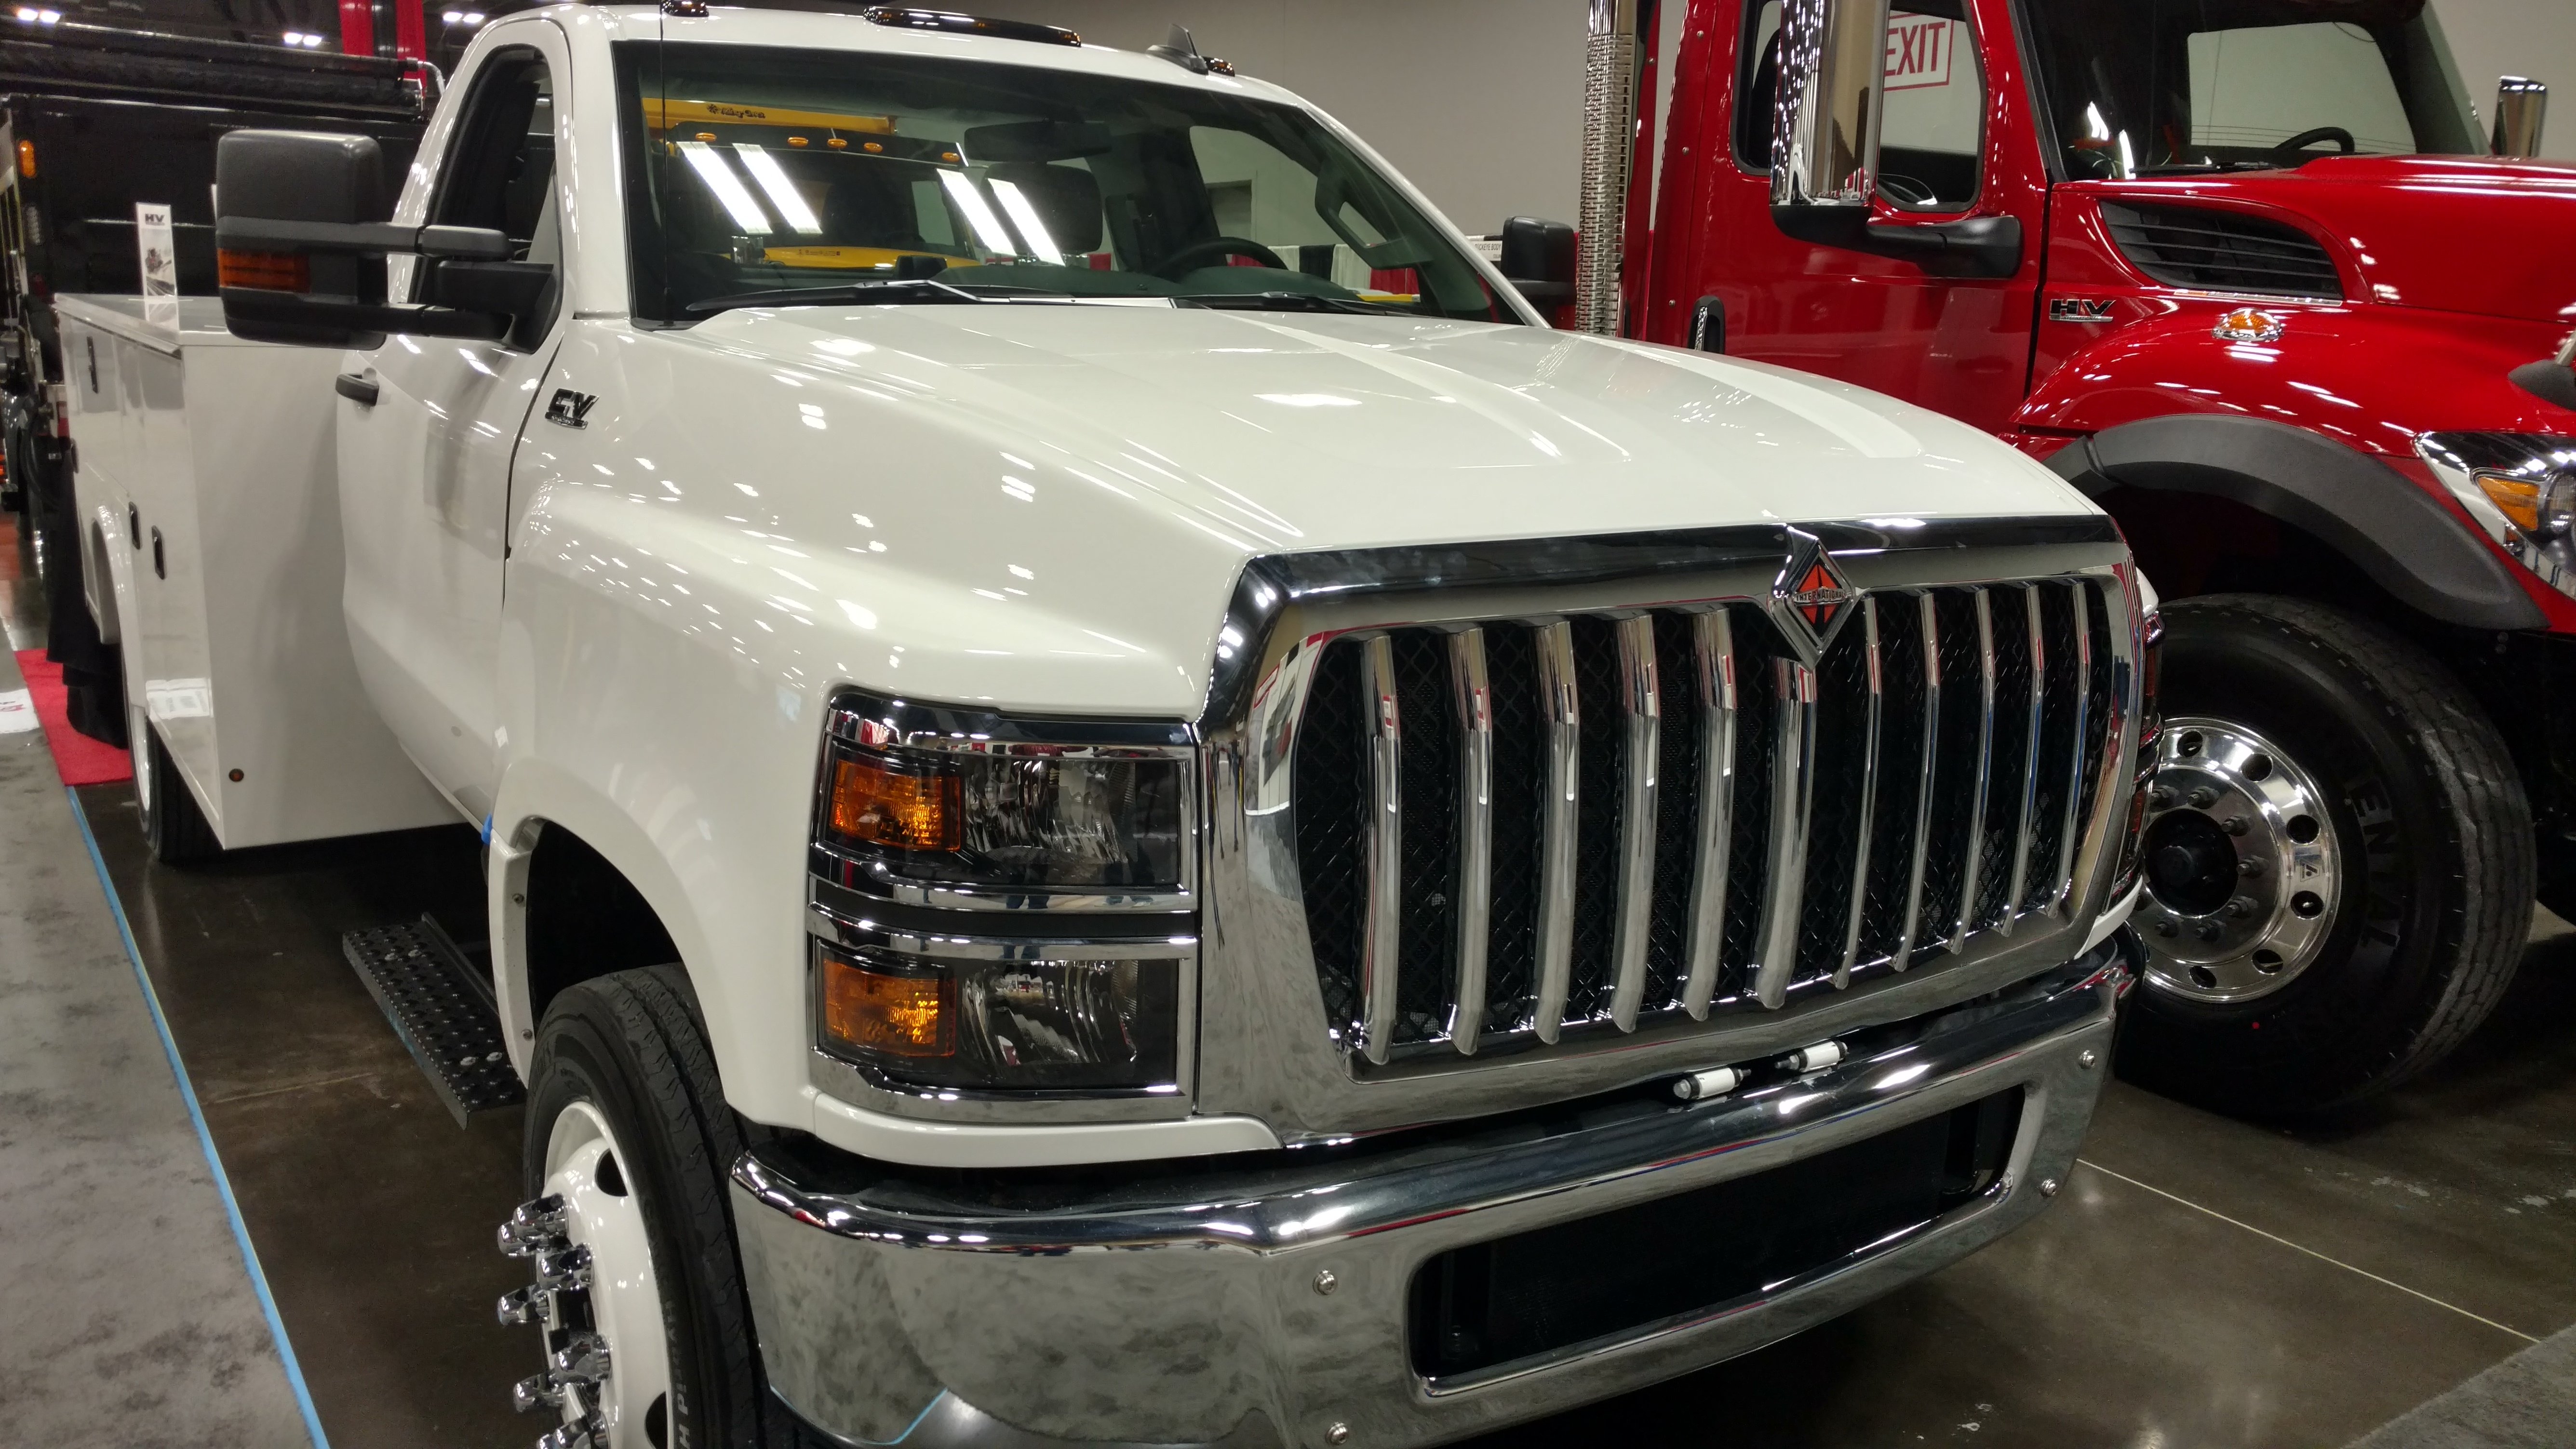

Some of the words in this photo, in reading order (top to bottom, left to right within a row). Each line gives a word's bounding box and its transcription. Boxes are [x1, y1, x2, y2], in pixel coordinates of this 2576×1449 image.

[1884, 21, 1946, 76] EXIT
[145, 214, 164, 222] HV
[2050, 299, 2116, 316] HV
[548, 388, 600, 420] CV
[1796, 589, 1846, 602] INTERNATIONAL
